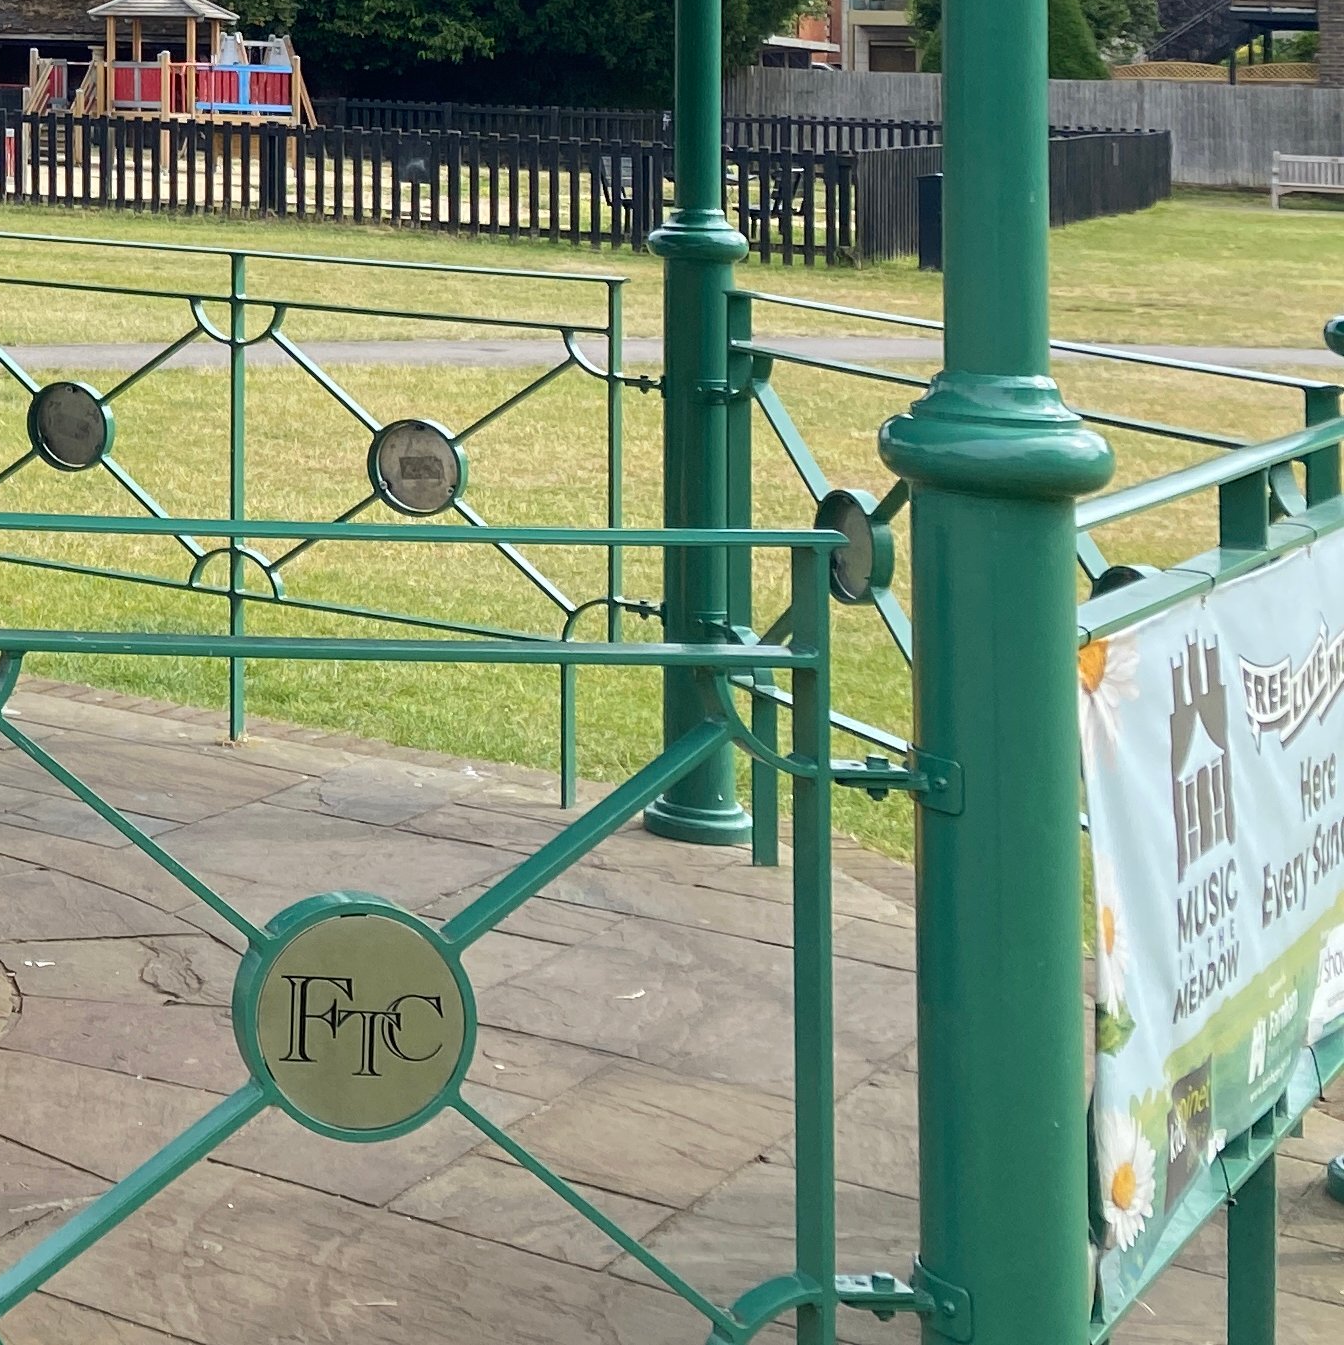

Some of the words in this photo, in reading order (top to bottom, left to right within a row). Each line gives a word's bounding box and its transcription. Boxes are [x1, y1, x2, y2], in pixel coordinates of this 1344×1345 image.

[1242, 665, 1291, 716] FREE
[1292, 640, 1326, 722] LIVE
[1300, 752, 1337, 823] Here
[1177, 858, 1239, 953] MUSIC
[1262, 846, 1311, 929] Every
[1207, 917, 1235, 958] THE
[1172, 940, 1240, 1025] MEADOW
[278, 975, 445, 1077] FTC
